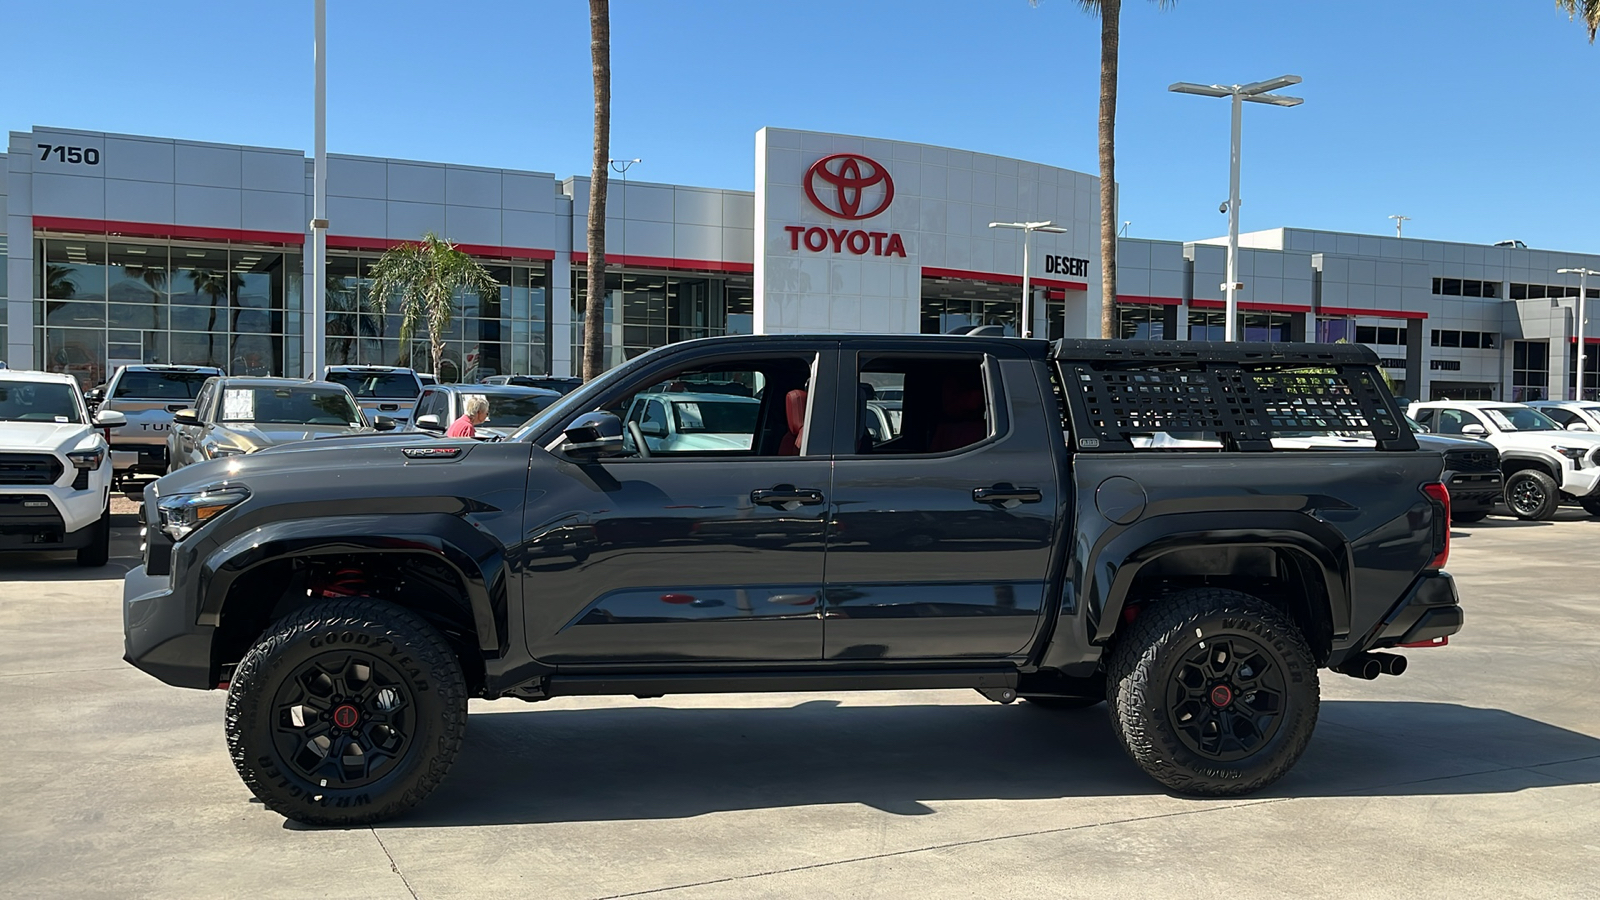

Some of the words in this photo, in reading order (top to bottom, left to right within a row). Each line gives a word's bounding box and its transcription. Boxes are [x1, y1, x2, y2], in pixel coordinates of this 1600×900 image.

[37, 143, 100, 166] 7150
[784, 225, 907, 258] TOYOTA
[1045, 254, 1090, 278] DESERT
[309, 631, 429, 693] GOODYEAR
[1222, 618, 1303, 683] WRANGLER
[258, 755, 372, 808] WRANGLER
